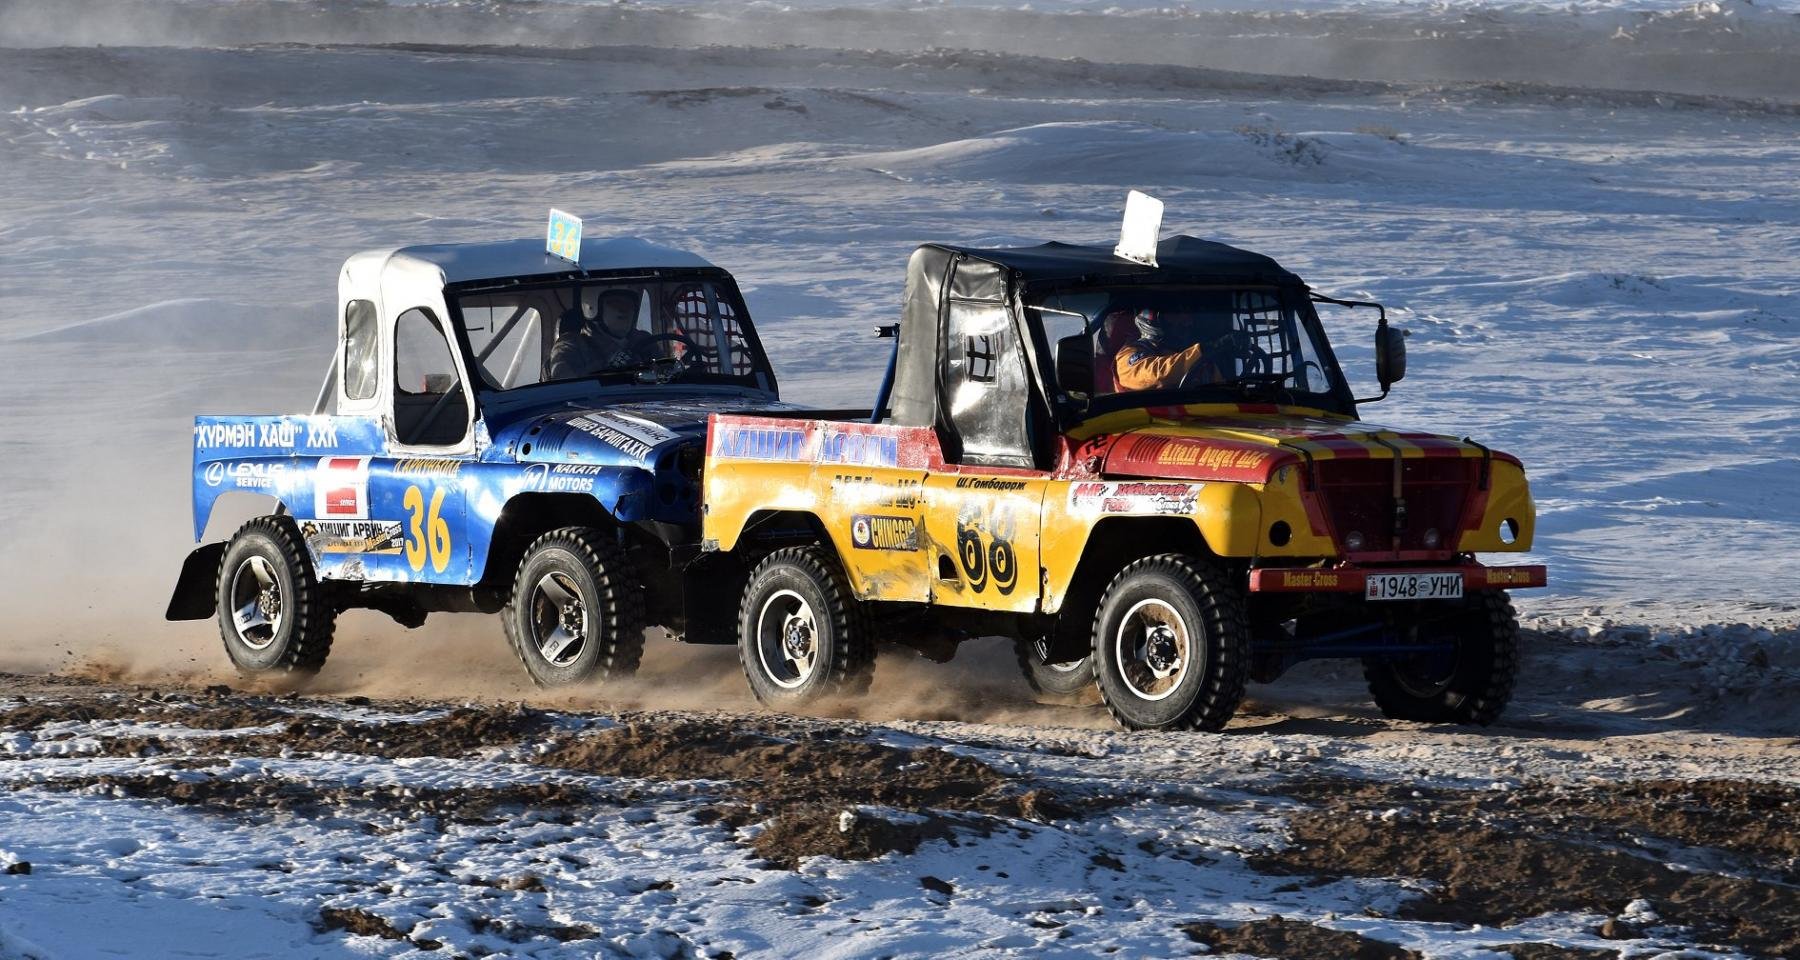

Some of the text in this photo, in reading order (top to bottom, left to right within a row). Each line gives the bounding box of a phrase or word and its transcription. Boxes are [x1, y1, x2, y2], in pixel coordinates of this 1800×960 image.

[551, 222, 577, 257] 36
[306, 424, 339, 448] ХХК
[553, 463, 602, 475] NAKATA
[236, 477, 274, 488] SERVICE
[549, 477, 594, 491] MOTORS
[403, 485, 451, 573] 36
[1379, 576, 1418, 598] 1948
[1429, 575, 1461, 596] УНИ
